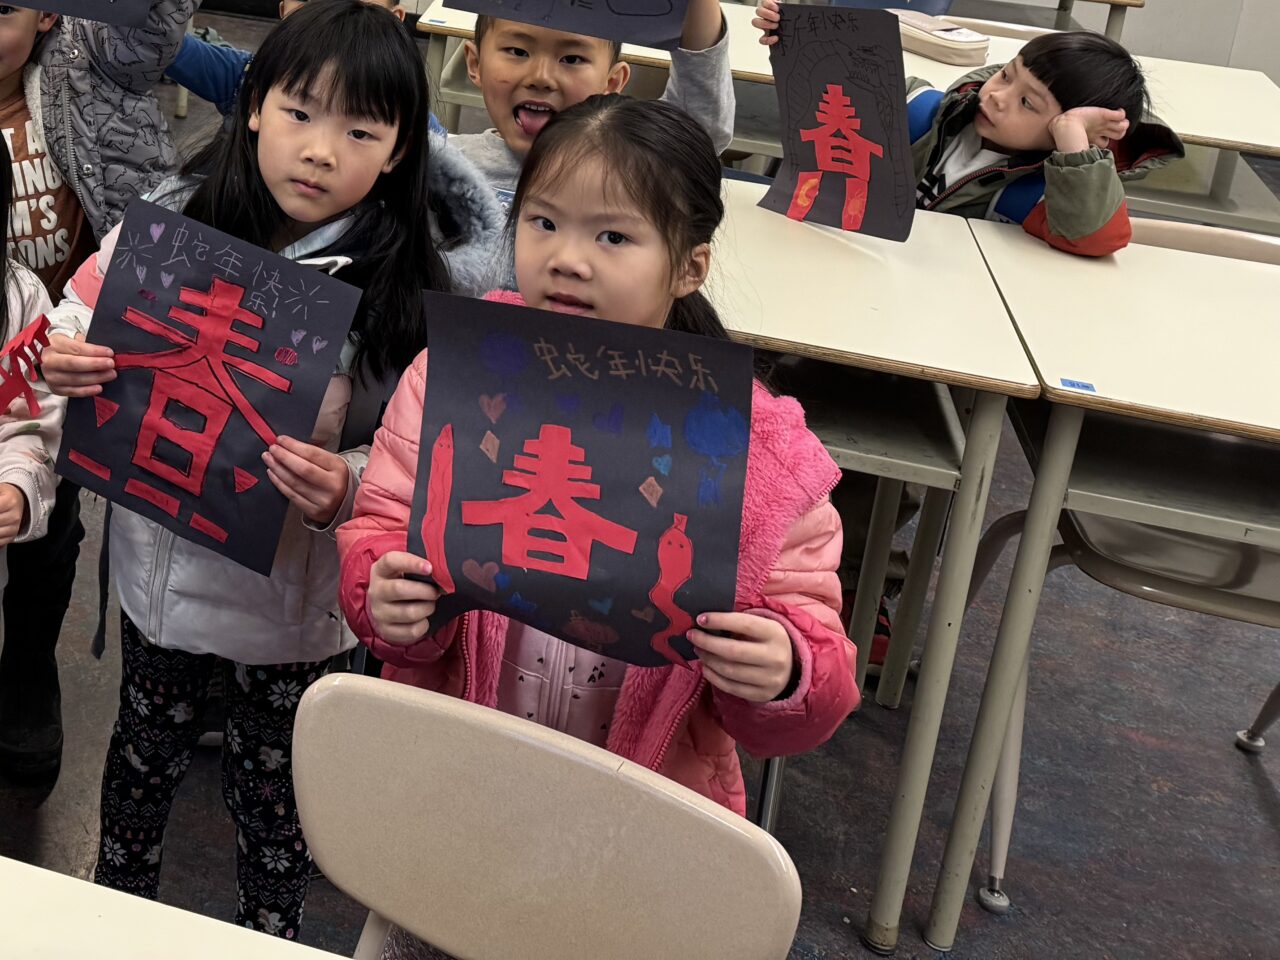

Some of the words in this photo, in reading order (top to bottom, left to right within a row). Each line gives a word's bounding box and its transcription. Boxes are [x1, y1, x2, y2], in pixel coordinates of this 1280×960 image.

[799, 84, 884, 182] 春
[113, 274, 293, 497] 春
[534, 337, 720, 393] 蛇年快乐
[462, 423, 639, 581] 春
